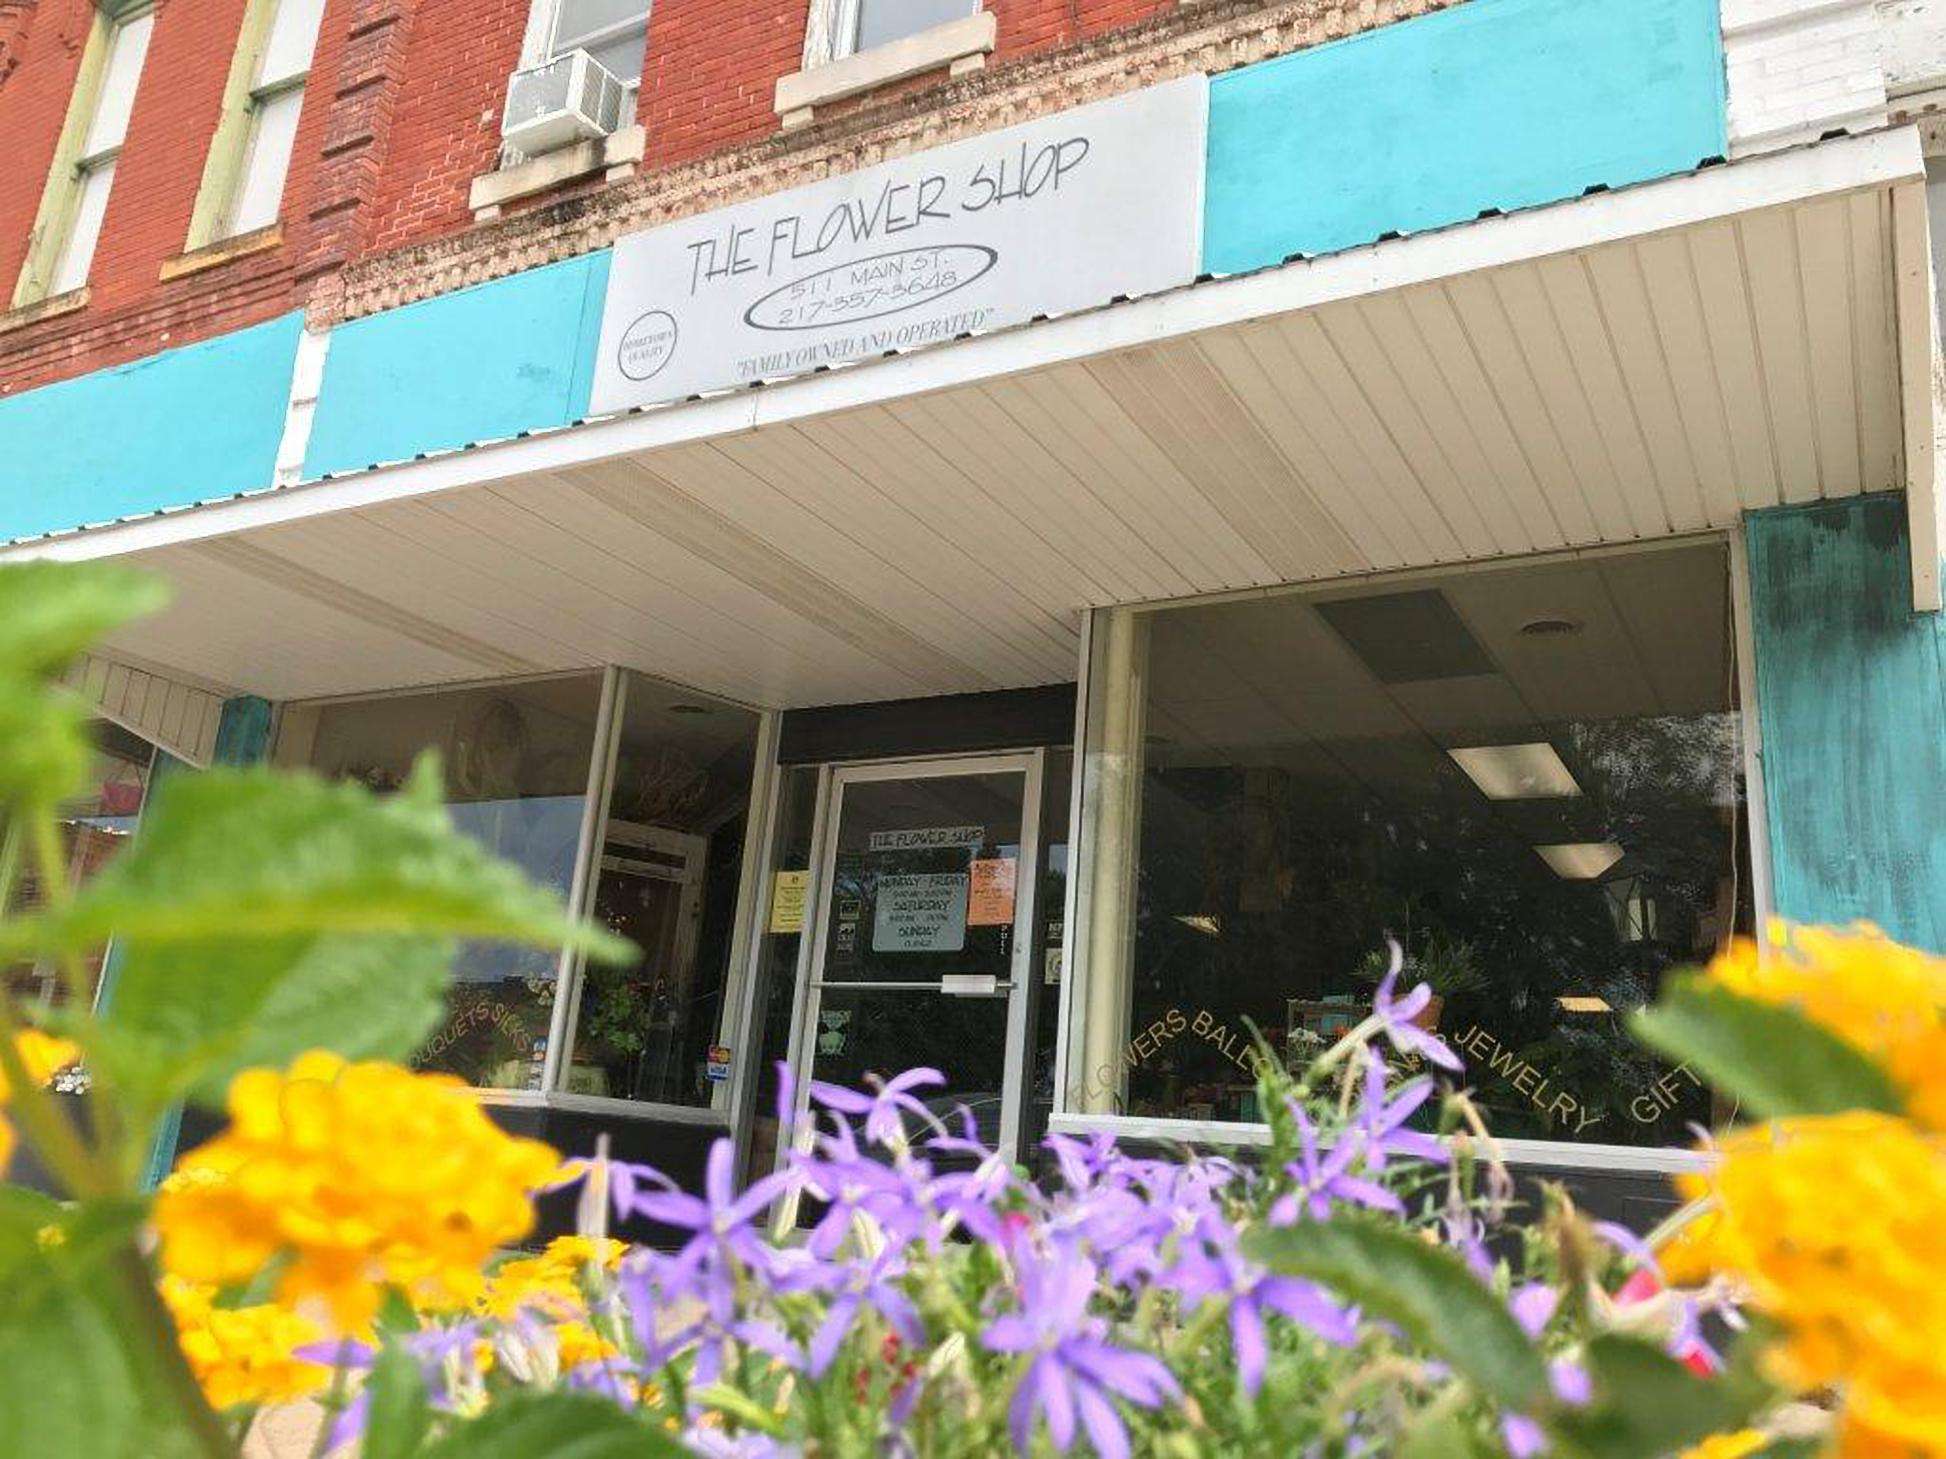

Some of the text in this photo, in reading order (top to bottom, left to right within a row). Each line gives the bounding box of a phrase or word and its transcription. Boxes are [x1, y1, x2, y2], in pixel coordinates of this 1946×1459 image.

[687, 137, 1089, 297] THE FLOWER SHOP
[790, 276, 832, 300] 511
[851, 255, 905, 286] MAIN
[794, 333, 856, 366] OWNED
[856, 328, 894, 351] AND
[1454, 1024, 1601, 1134] JEWELRY
